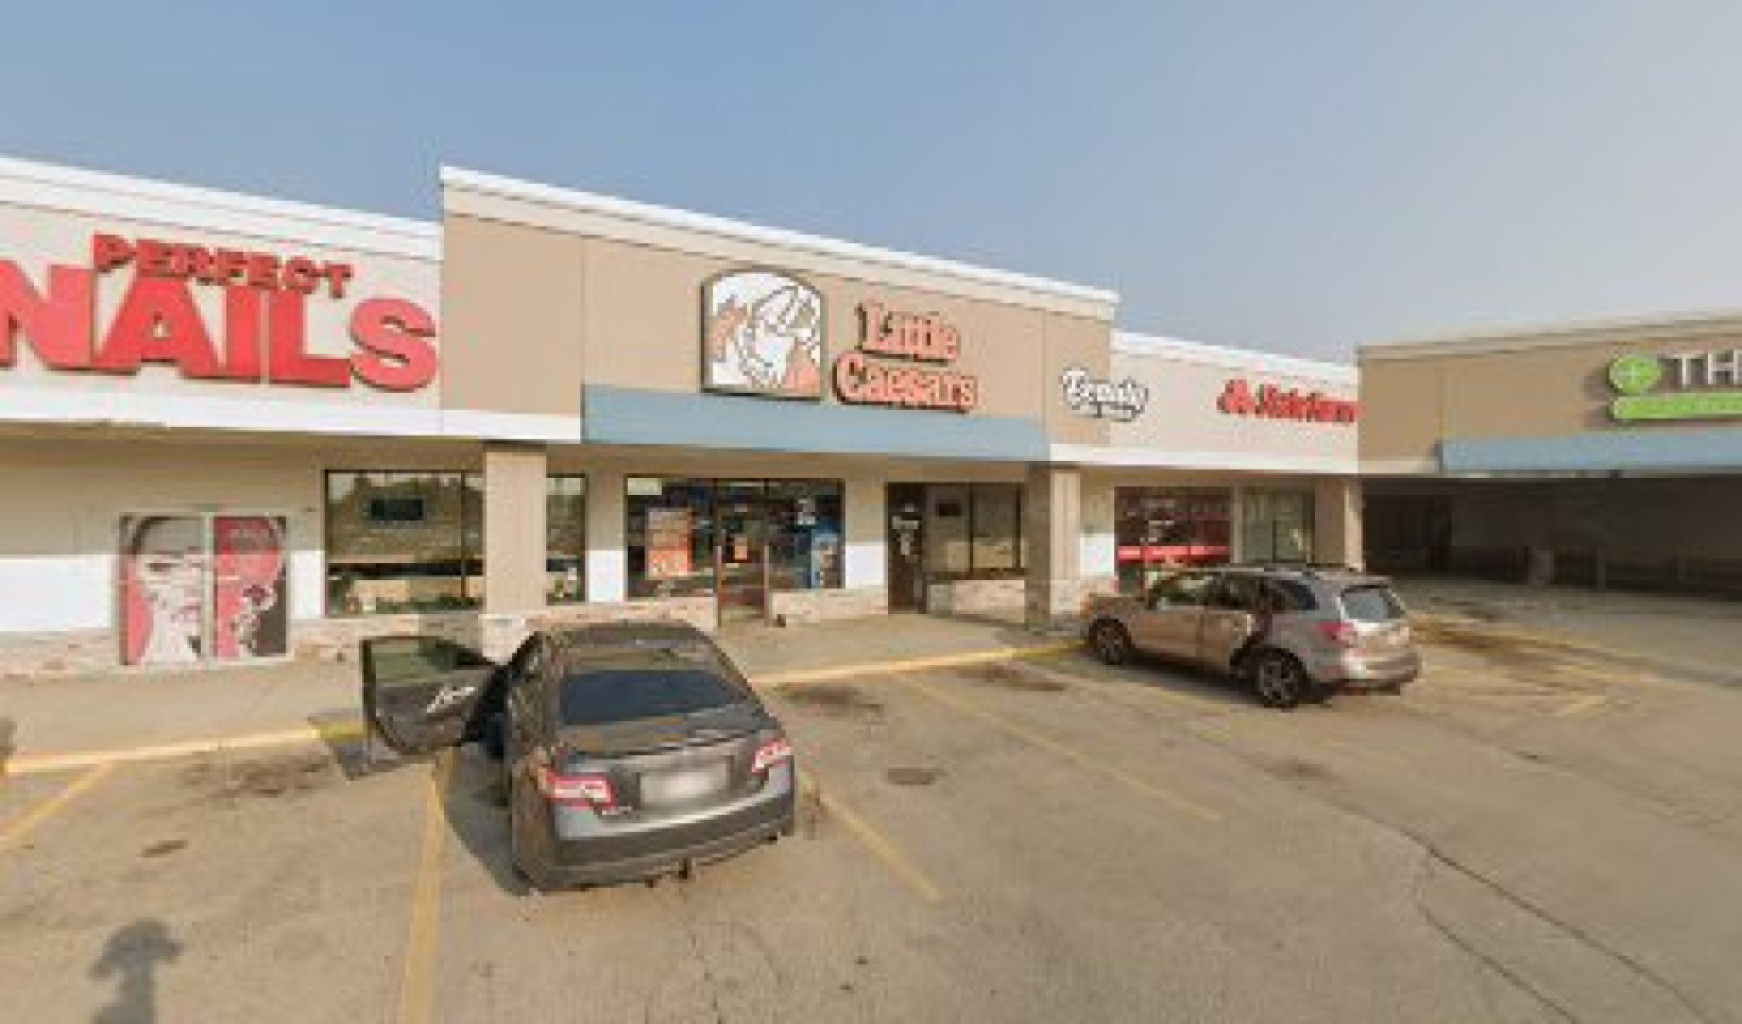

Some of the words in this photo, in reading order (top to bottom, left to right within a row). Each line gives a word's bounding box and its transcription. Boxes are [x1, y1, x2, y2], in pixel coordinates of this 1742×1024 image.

[93, 233, 353, 299] PERFECT
[0, 259, 437, 392] NAILS
[855, 298, 960, 362] Little
[832, 351, 977, 413] Caesars
